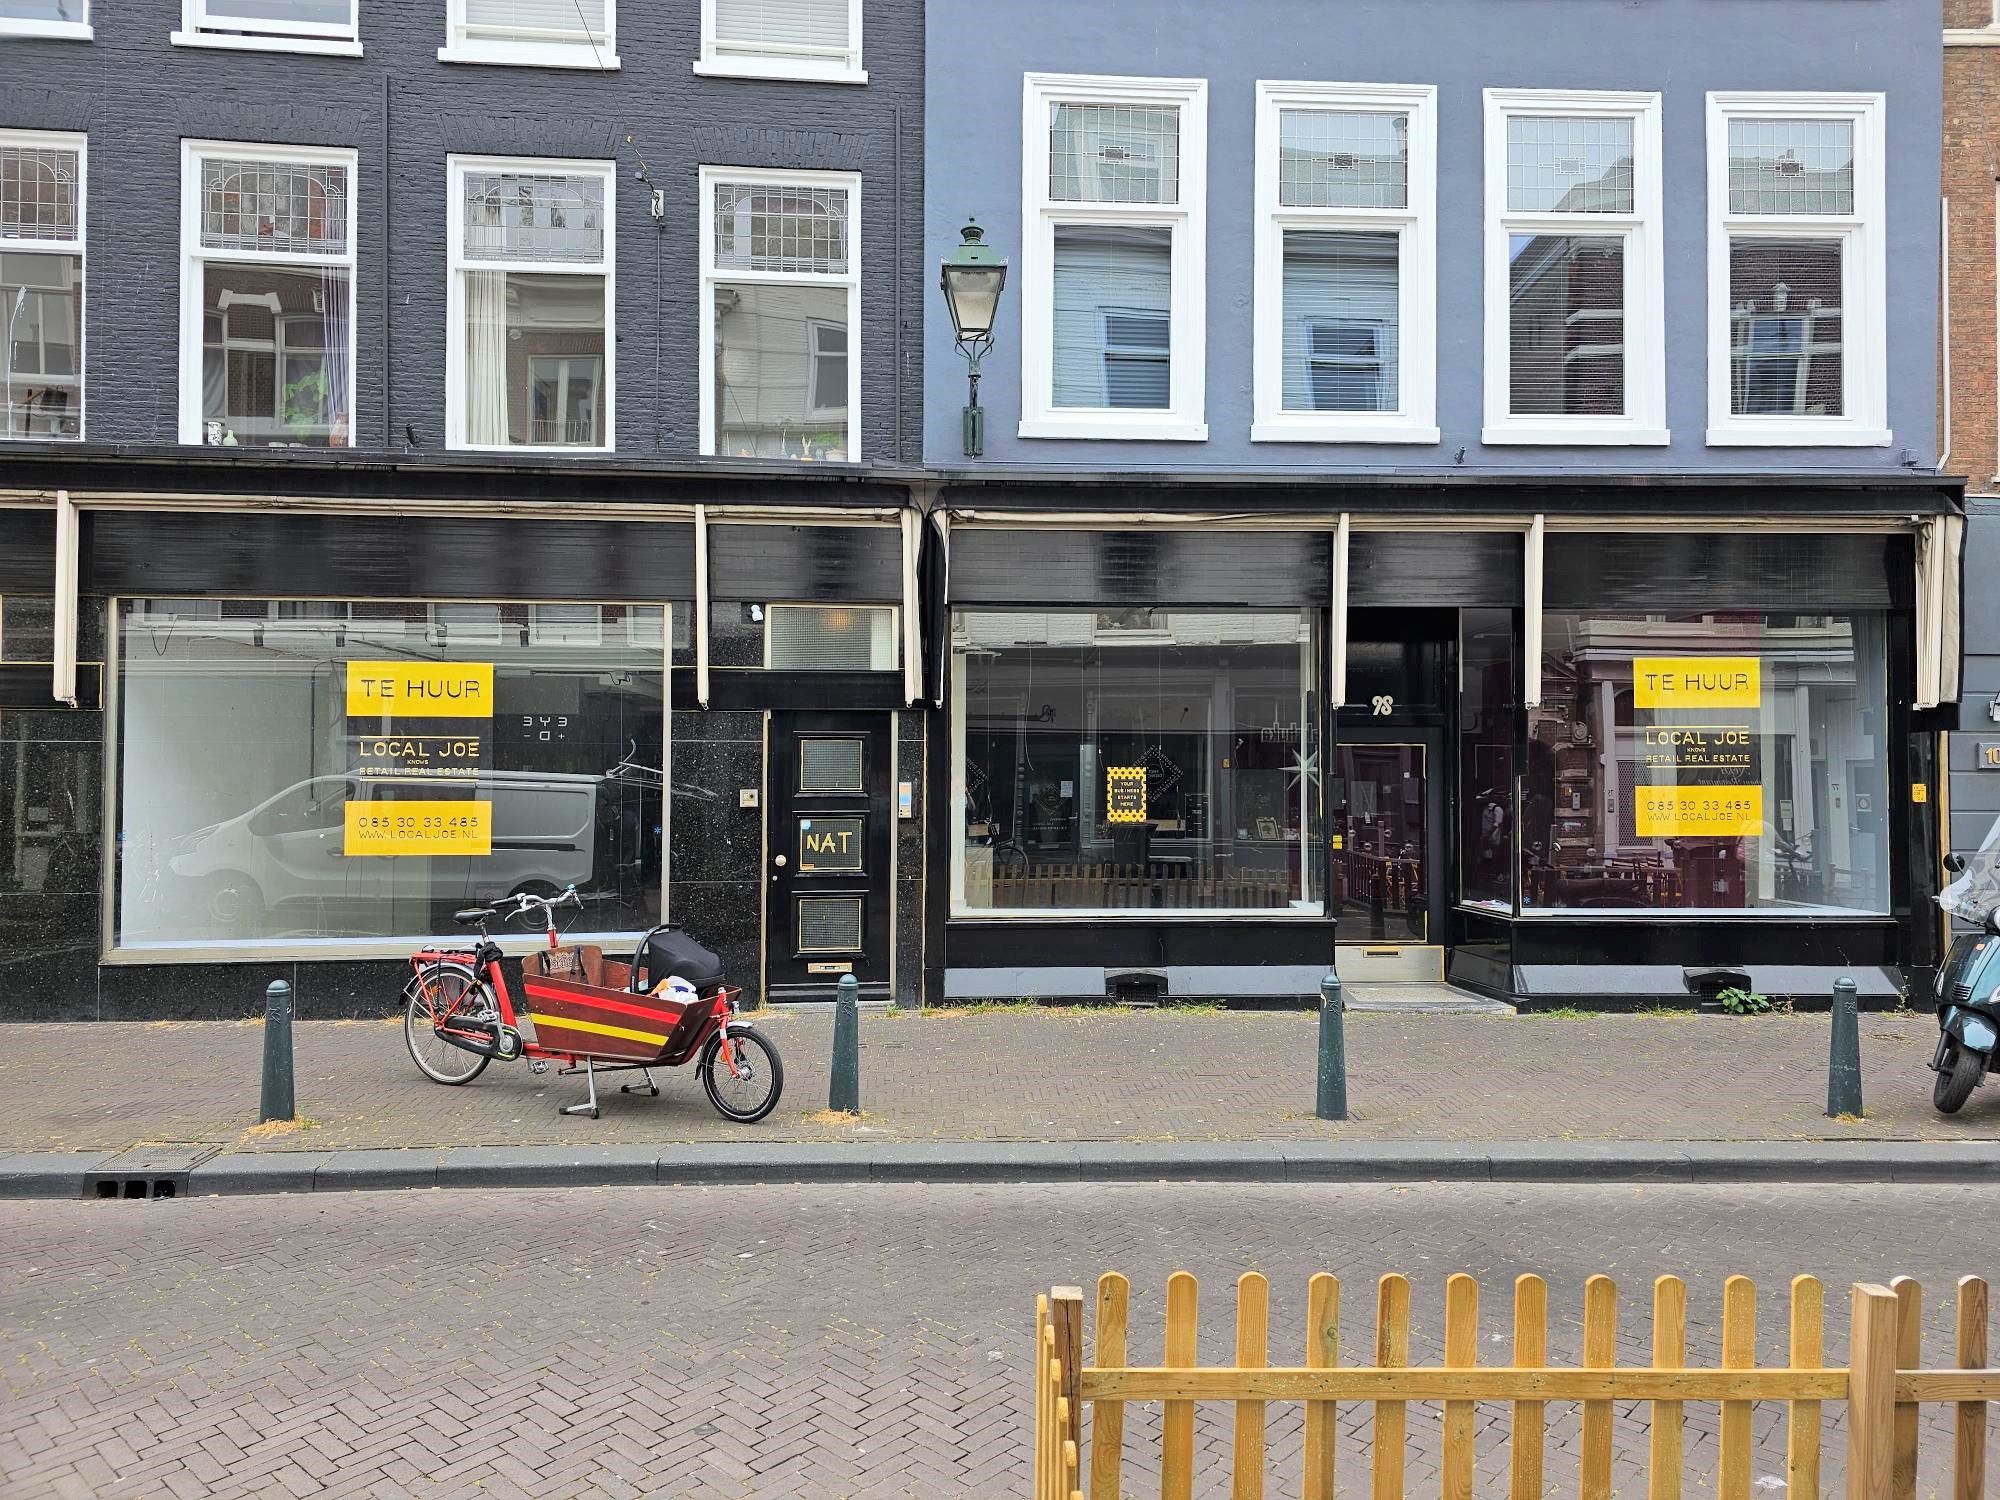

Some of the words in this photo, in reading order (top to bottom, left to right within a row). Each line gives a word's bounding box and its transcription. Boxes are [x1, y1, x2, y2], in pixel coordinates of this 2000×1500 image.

[361, 680, 395, 698] TE
[407, 680, 480, 698] HUUR
[1645, 673, 1675, 690] TE
[1685, 673, 1749, 690] HUUR
[1371, 695, 1394, 716] 98
[1645, 731, 1707, 745] LOCAL
[1714, 731, 1750, 745] JOE
[359, 741, 430, 757] LOCAL
[438, 741, 480, 757] JOE
[1645, 754, 1682, 763] RETAIL
[1685, 754, 1710, 763] REAL
[1713, 754, 1751, 763] ESTATE
[359, 767, 401, 776] RETAIL
[404, 767, 433, 776] REAL
[437, 767, 480, 776] ESTATE
[1647, 801, 1674, 811] 085
[1680, 801, 1696, 811] 30
[1702, 801, 1720, 811] 33
[1725, 801, 1751, 811] 485
[358, 817, 390, 828] 085
[396, 817, 416, 828] 30
[423, 817, 443, 828] 33
[449, 817, 479, 828] 485
[806, 831, 853, 854] NAT
